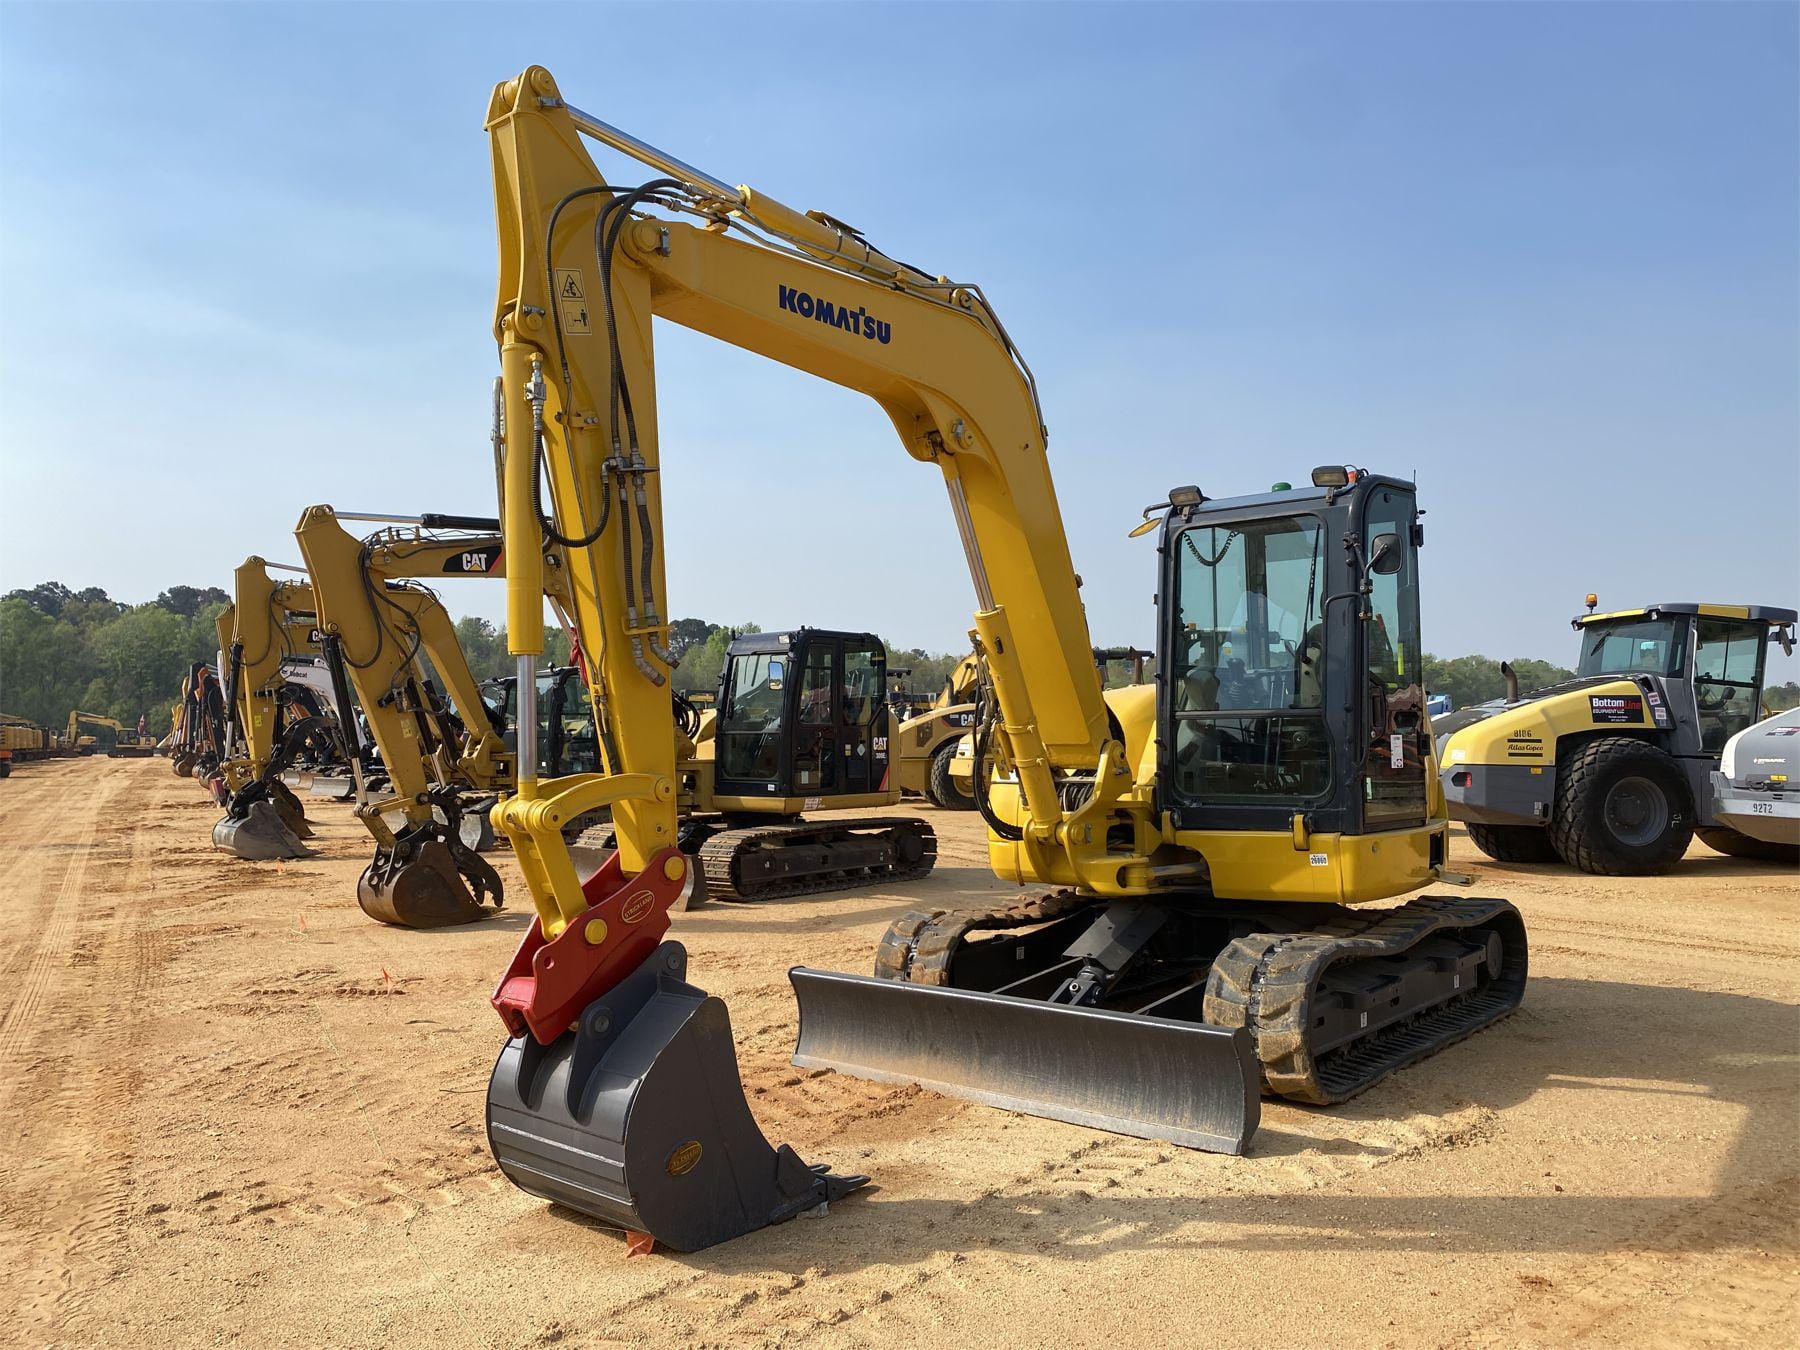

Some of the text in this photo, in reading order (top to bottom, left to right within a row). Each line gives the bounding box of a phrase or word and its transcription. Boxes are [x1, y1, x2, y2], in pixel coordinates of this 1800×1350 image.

[779, 284, 891, 344] KOMATSU
[462, 553, 487, 571] CAT
[1592, 698, 1625, 707] Bottom
[960, 714, 976, 726] CA
[873, 736, 888, 750] CAT
[1525, 744, 1544, 752] Copco
[1753, 803, 1773, 814] 9272
